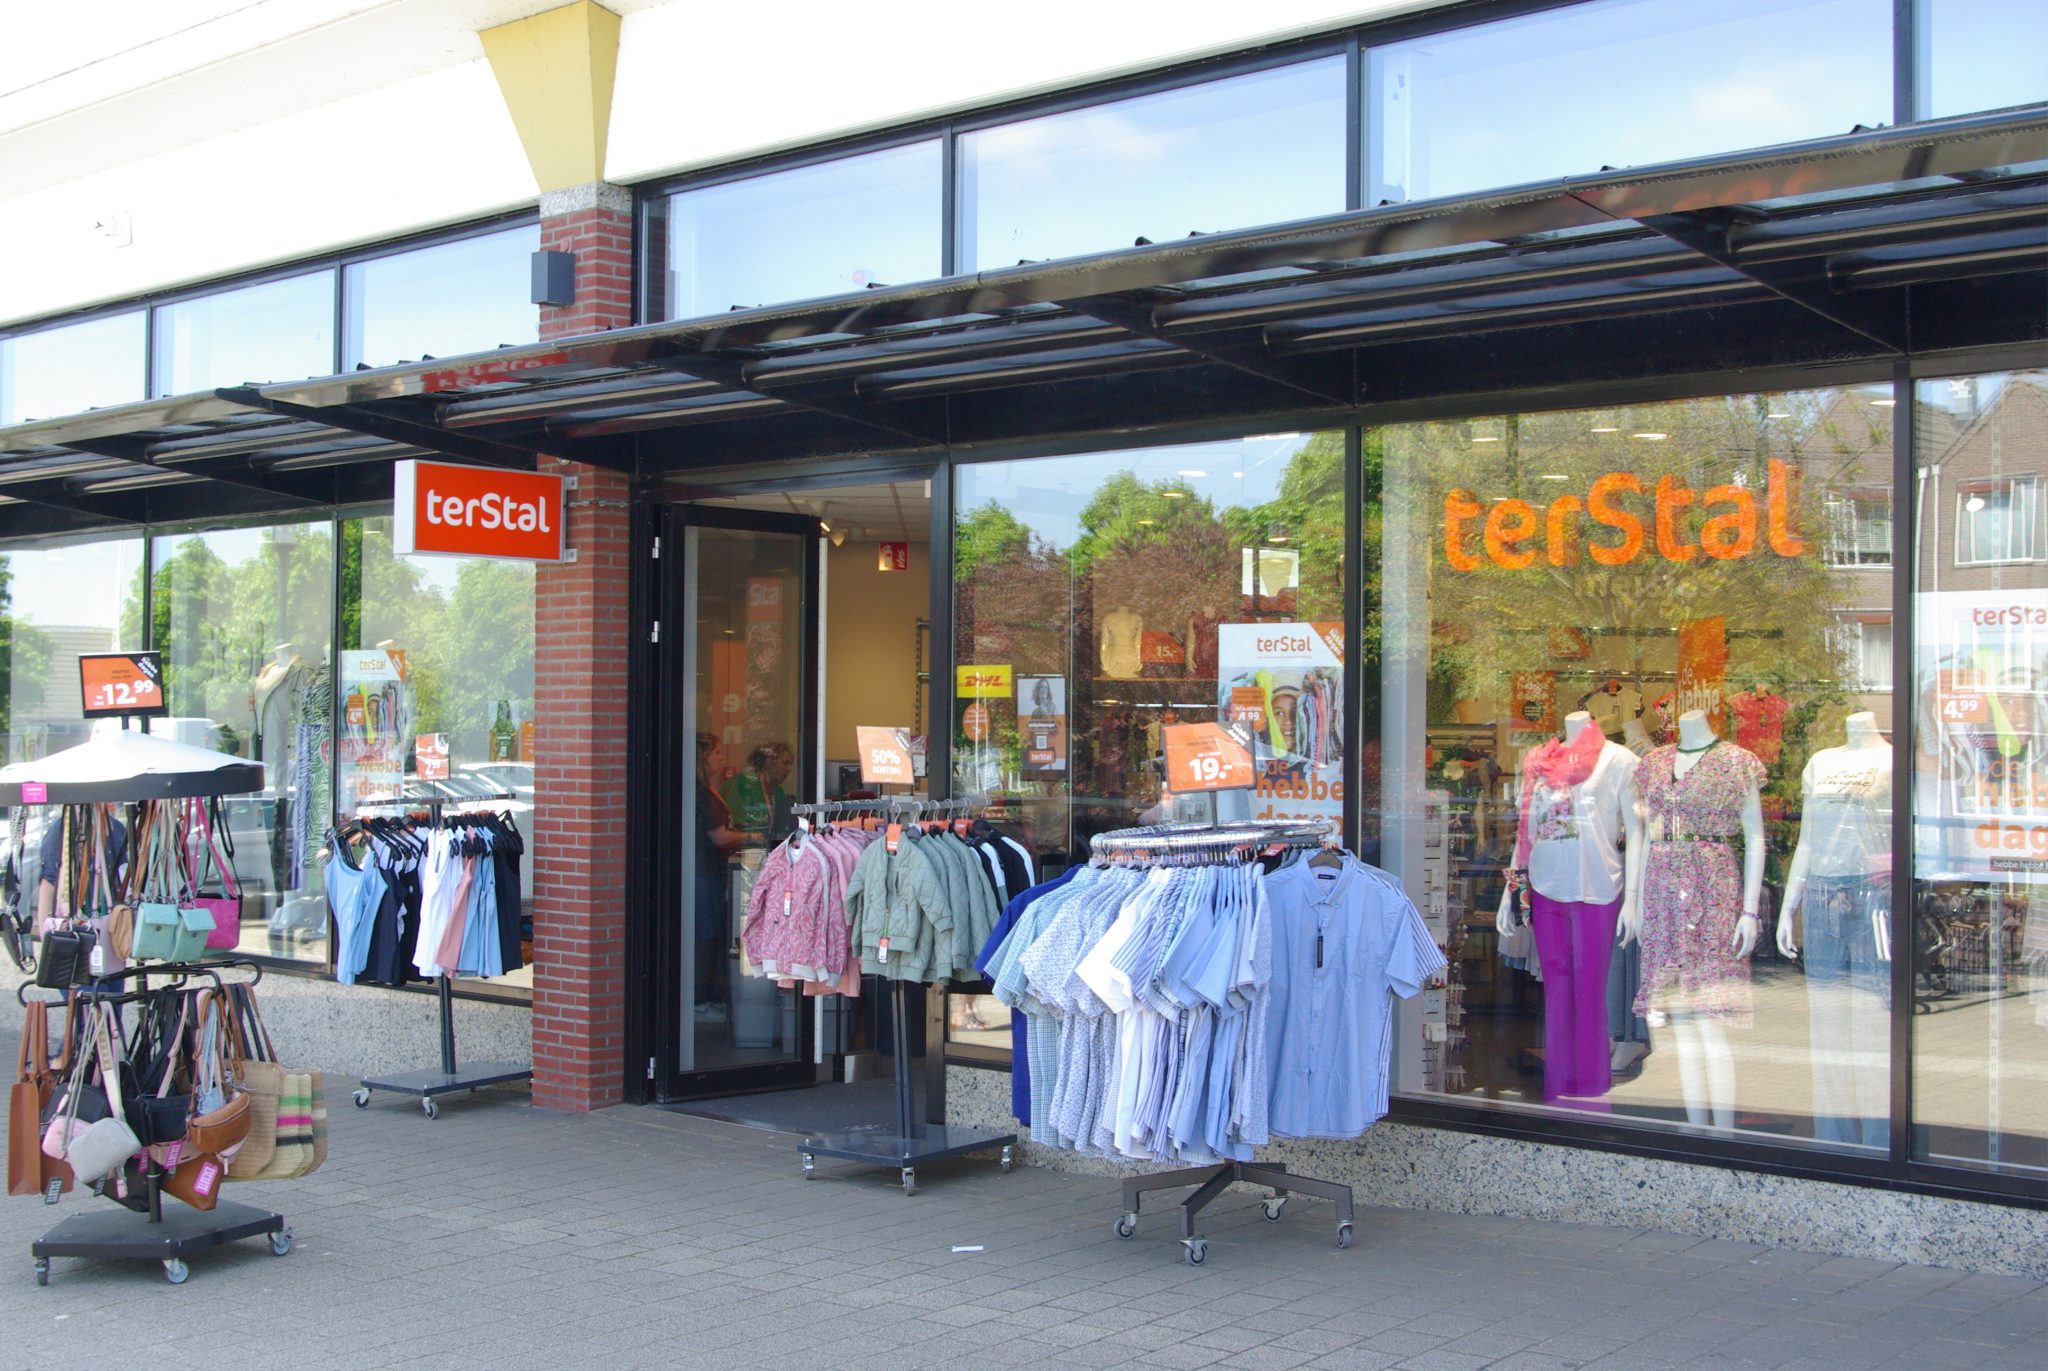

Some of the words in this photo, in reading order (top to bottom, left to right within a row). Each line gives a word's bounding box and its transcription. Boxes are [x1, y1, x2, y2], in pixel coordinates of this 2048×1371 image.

[427, 489, 550, 533] terStal
[1445, 458, 1803, 571] terStal
[1973, 606, 2047, 626] terSta
[1256, 636, 1312, 652] terStal
[360, 658, 386, 670] terStal
[965, 675, 1003, 687] DHL
[102, 680, 154, 705] 12.99
[1944, 700, 1977, 719] 4.99
[871, 749, 901, 765] 50%
[1189, 757, 1233, 782] 19.-
[1267, 758, 1289, 776] de
[1257, 770, 1344, 801] hebbe
